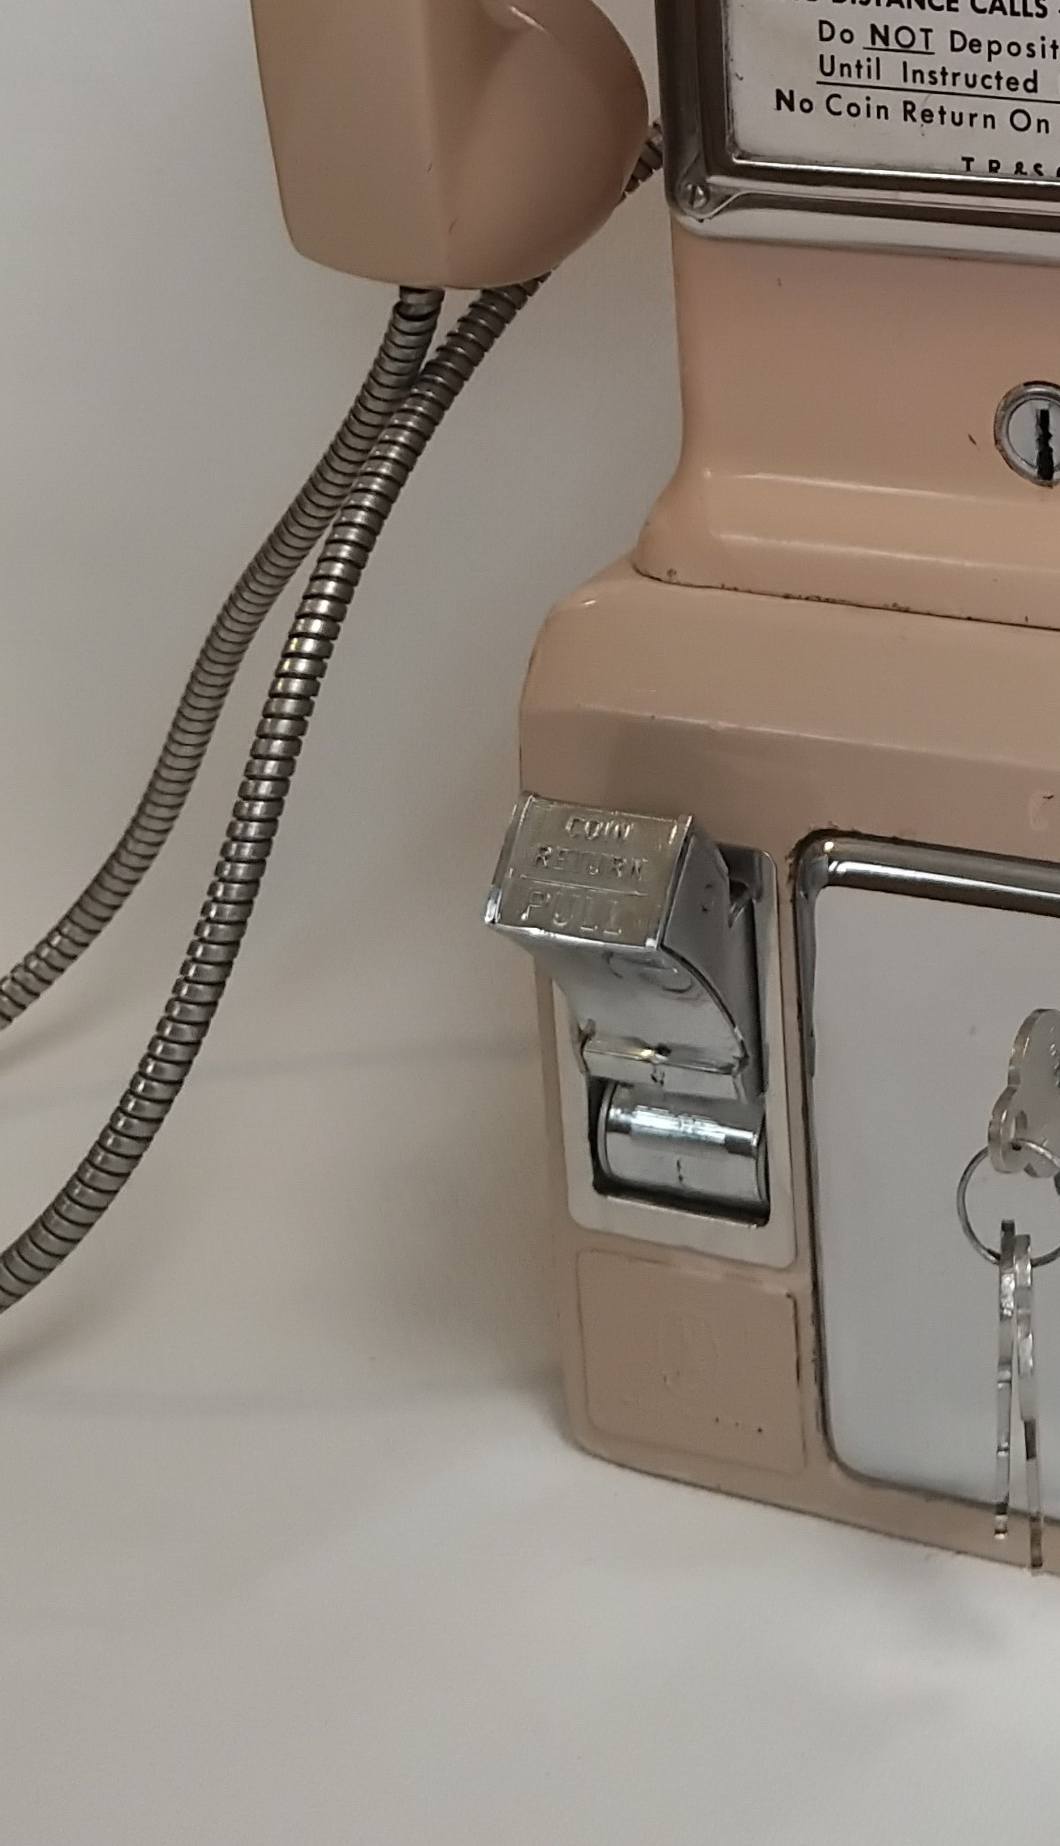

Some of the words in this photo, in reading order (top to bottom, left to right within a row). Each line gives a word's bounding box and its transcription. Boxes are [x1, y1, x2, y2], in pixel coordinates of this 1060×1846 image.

[818, 19, 854, 44] Do
[870, 23, 933, 51] NOT
[949, 30, 1059, 62] Deposit
[819, 54, 881, 80] Until
[902, 61, 1038, 93] Instructed
[775, 89, 814, 113] No
[825, 94, 889, 120] Coin
[902, 100, 996, 130] Return
[1009, 109, 1050, 134] On
[520, 890, 623, 937] PULL
